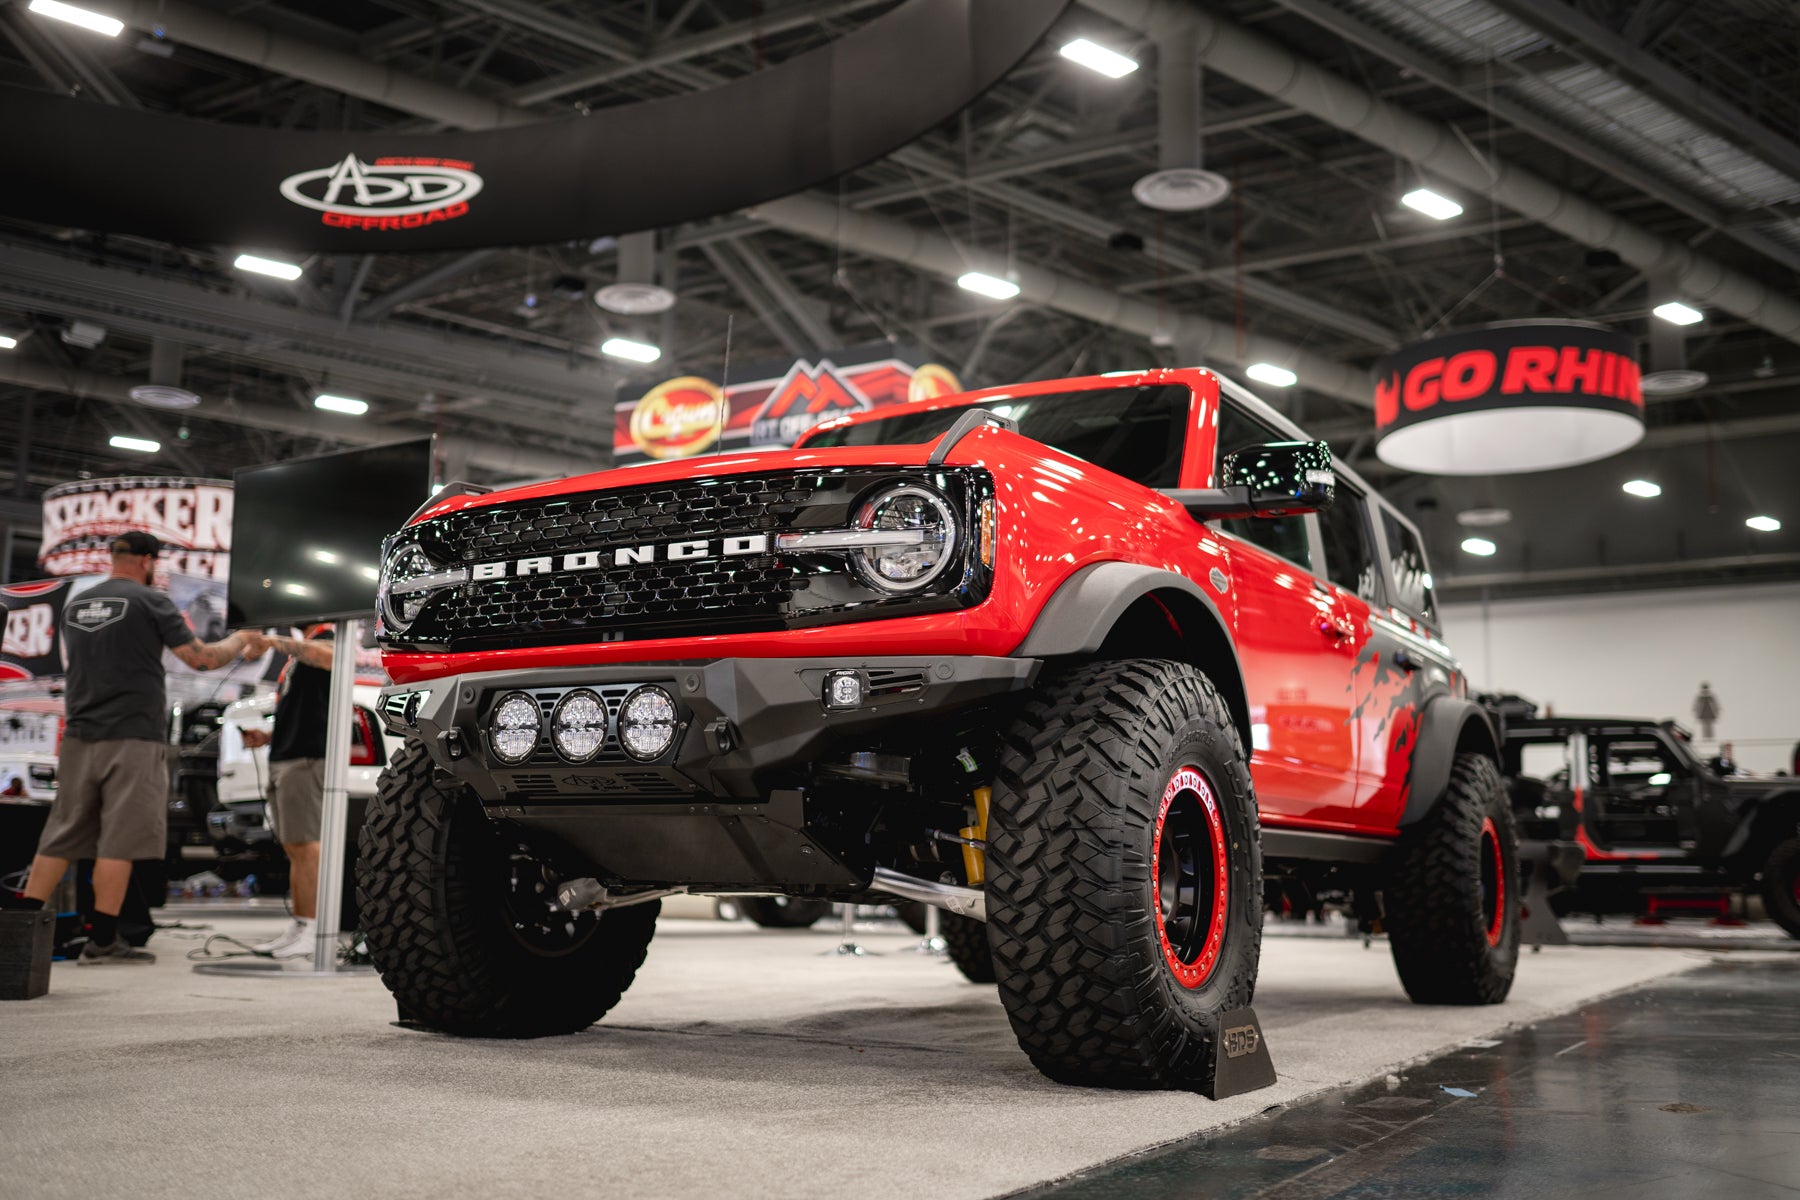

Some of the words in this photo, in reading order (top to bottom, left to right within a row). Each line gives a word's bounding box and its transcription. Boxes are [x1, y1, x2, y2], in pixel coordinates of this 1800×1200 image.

[322, 201, 469, 231] OFFROAD
[1402, 349, 1498, 412] GO
[473, 535, 767, 581] BRONCO
[1227, 1027, 1256, 1057] BDS
